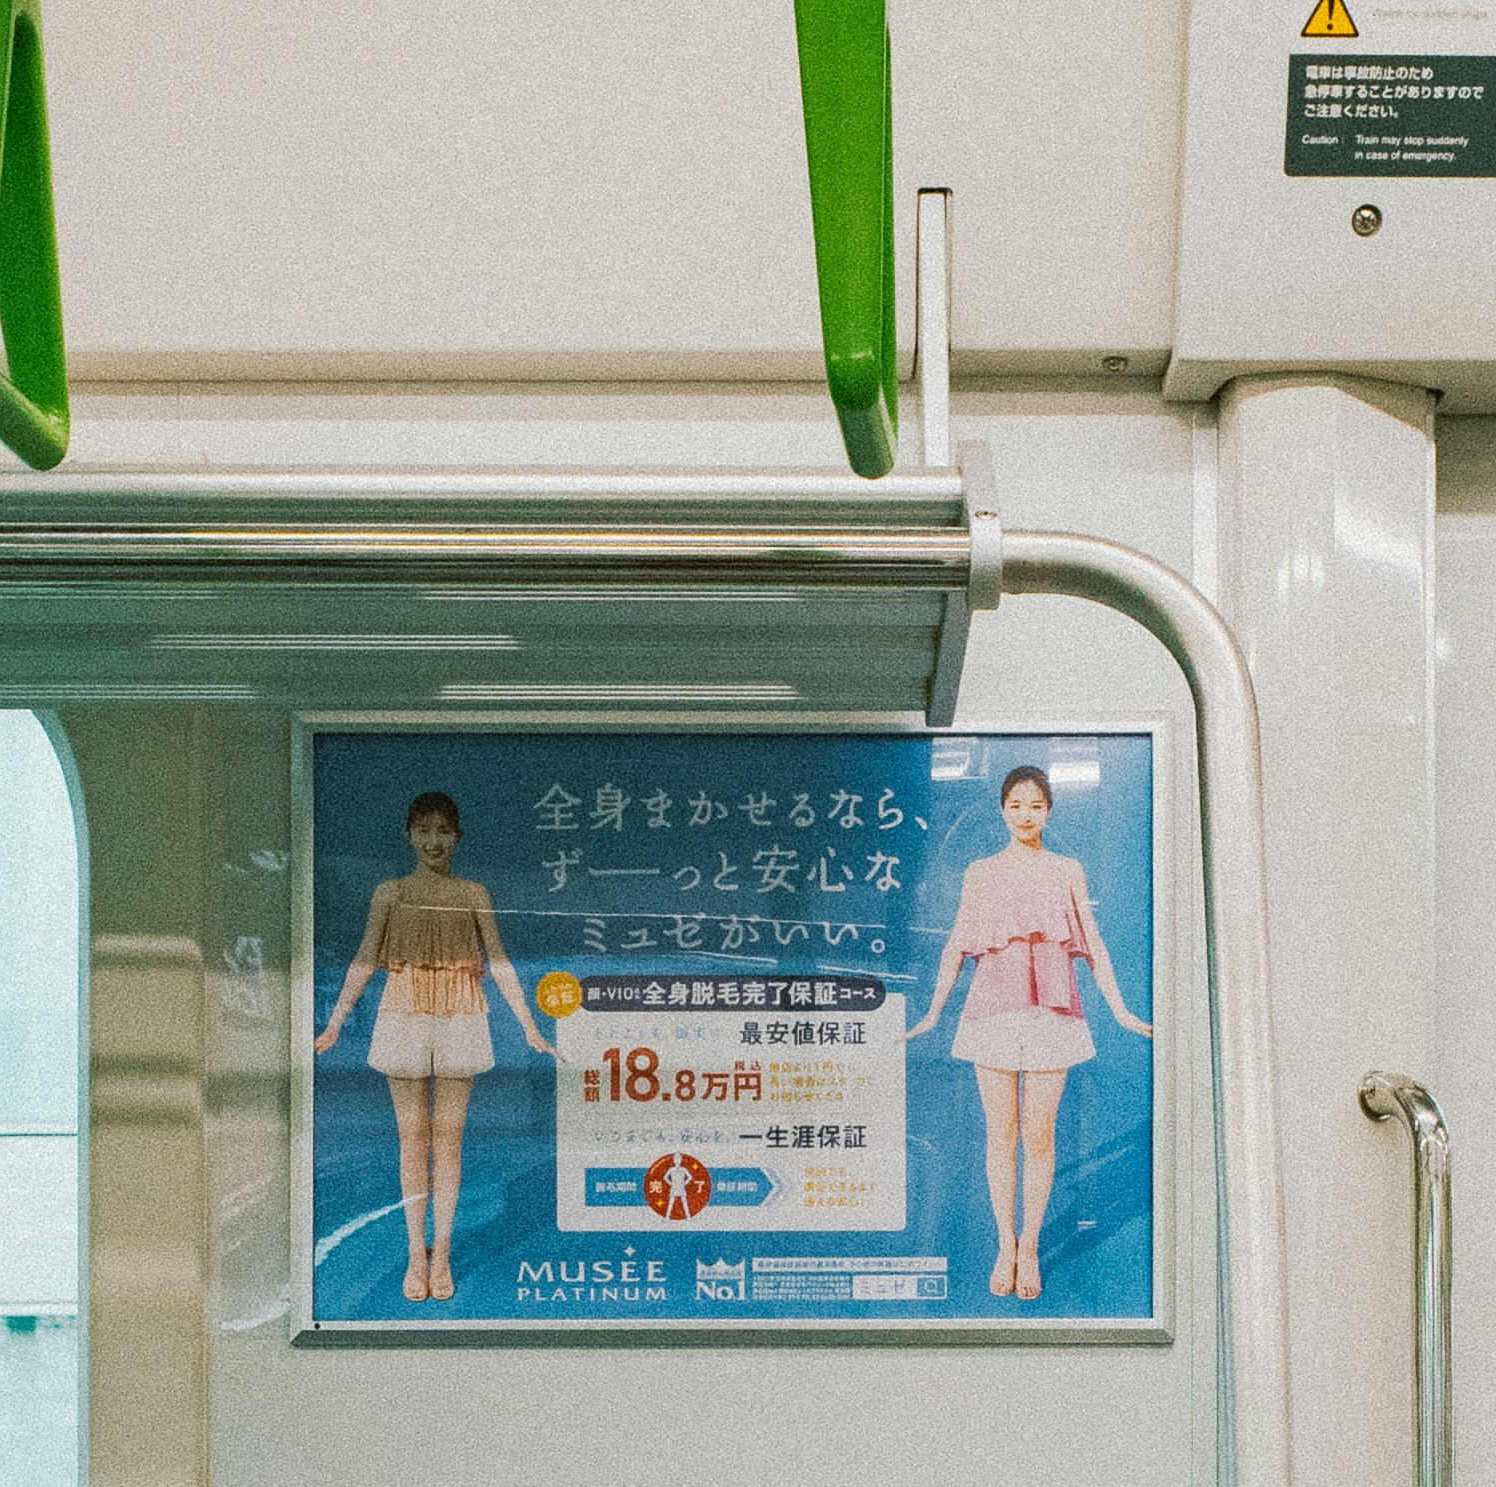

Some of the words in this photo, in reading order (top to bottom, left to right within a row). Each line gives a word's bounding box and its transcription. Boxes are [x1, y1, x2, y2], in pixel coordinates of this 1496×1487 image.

[1304, 85, 1485, 100] 急停車することがありますので
[1304, 104, 1399, 119] ご注意ください。
[1302, 134, 1339, 146] Caution
[1356, 135, 1379, 145] Train
[1381, 137, 1401, 148] may
[1403, 136, 1424, 147] stop
[1426, 135, 1469, 148] suddenly
[1355, 151, 1364, 160] in
[1365, 152, 1388, 161] case
[1390, 151, 1401, 160] of
[1402, 152, 1457, 163] emergency.
[532, 781, 930, 832] 全身まかせるなら、
[582, 912, 887, 955] ミュゼがいい。
[739, 1021, 867, 1045] 最安値保証
[739, 1126, 868, 1149] 一生涯保証
[649, 1180, 663, 1194] 完
[694, 1180, 706, 1194] 了
[516, 1287, 667, 1302] PLATINUM
